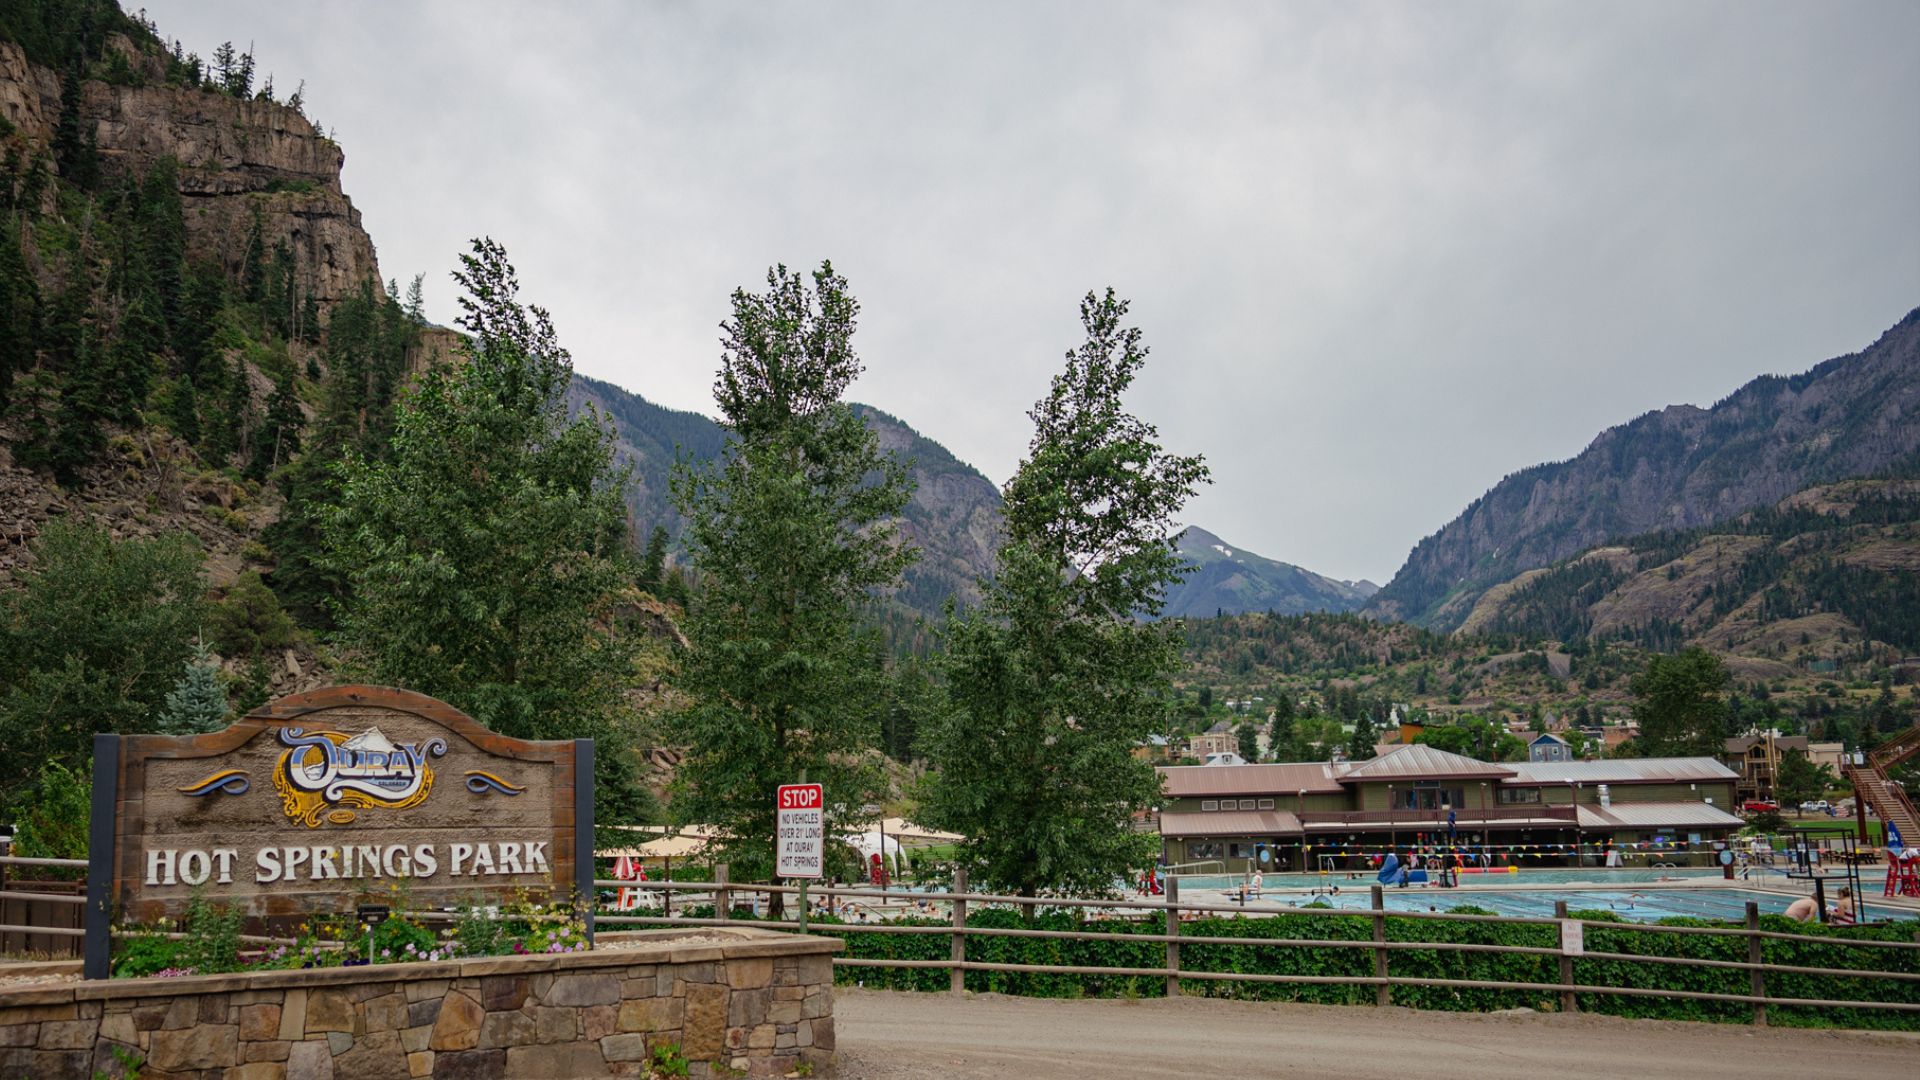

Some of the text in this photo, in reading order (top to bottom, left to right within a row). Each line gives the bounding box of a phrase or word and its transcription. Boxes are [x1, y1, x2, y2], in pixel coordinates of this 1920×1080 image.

[280, 727, 447, 802] OURAY
[783, 789, 818, 807] STOP
[782, 813, 818, 825] NO VEHICLES
[780, 828, 794, 839] OVER
[805, 827, 821, 839] LONG
[786, 842, 814, 853] AT OURAY
[145, 841, 551, 886] HOT SPRINGS PARK
[781, 856, 818, 867] HOT SPRINGS
